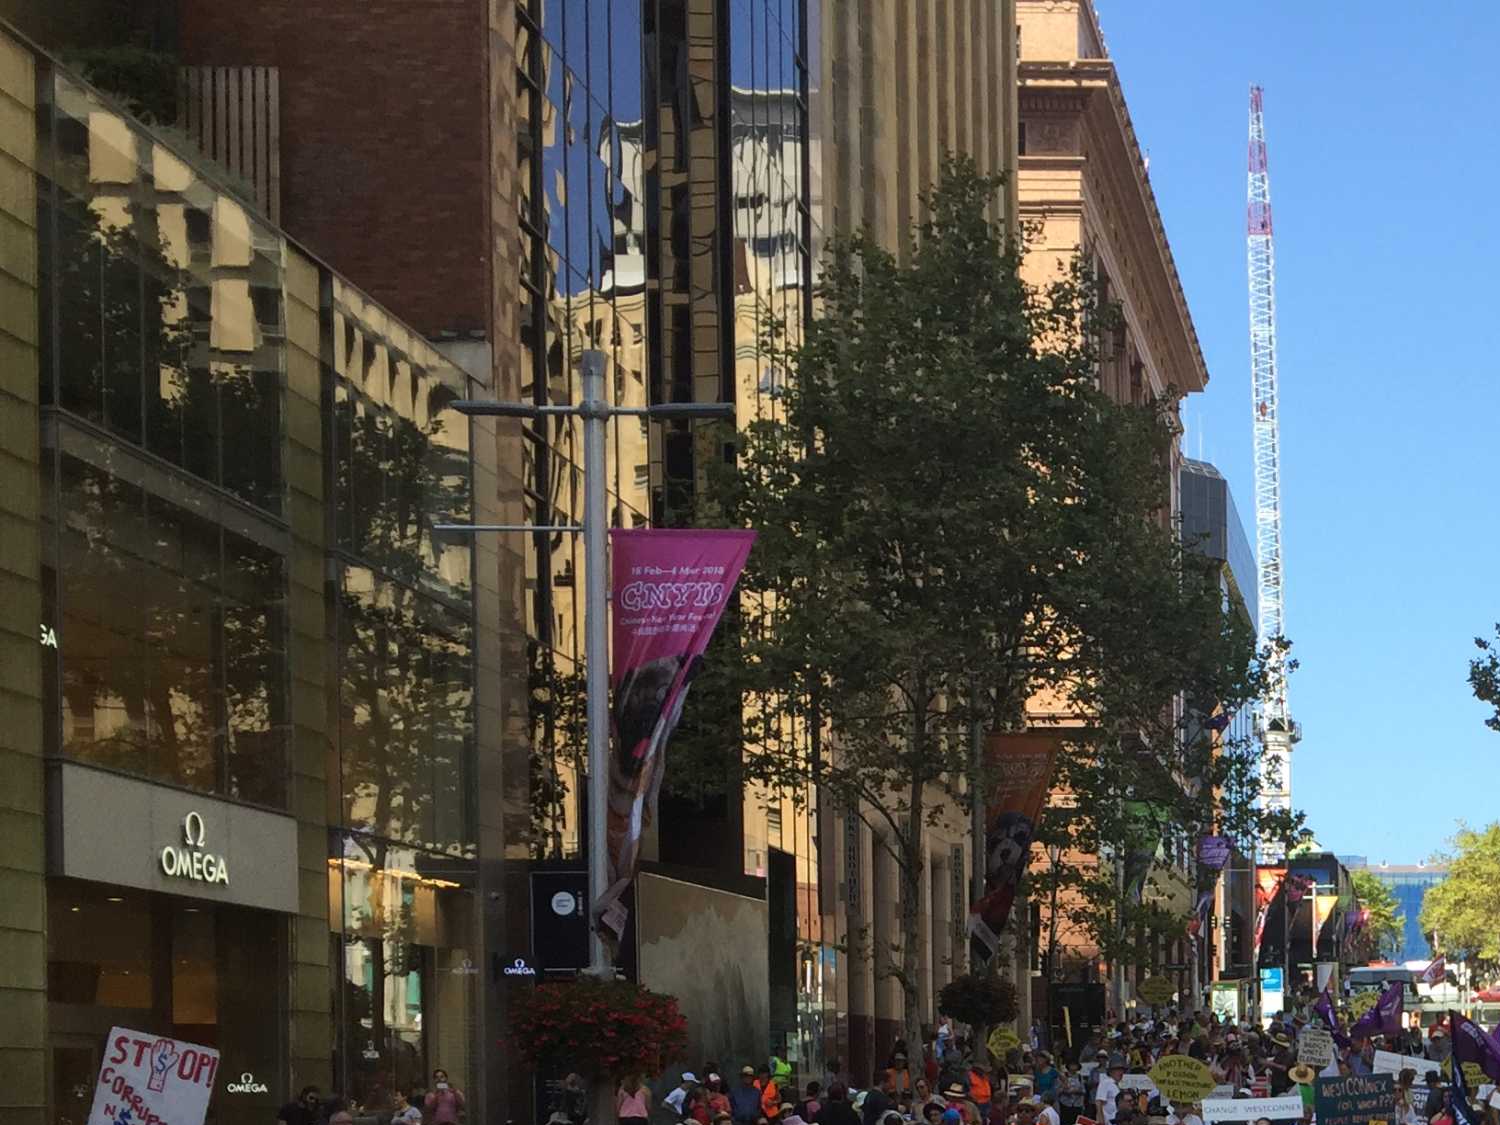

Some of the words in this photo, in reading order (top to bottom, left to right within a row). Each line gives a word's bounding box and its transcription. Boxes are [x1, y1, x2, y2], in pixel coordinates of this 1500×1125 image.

[161, 846, 230, 885] OMEGA
[504, 966, 536, 976] OMEGA
[227, 1082, 268, 1094] OMEGA
